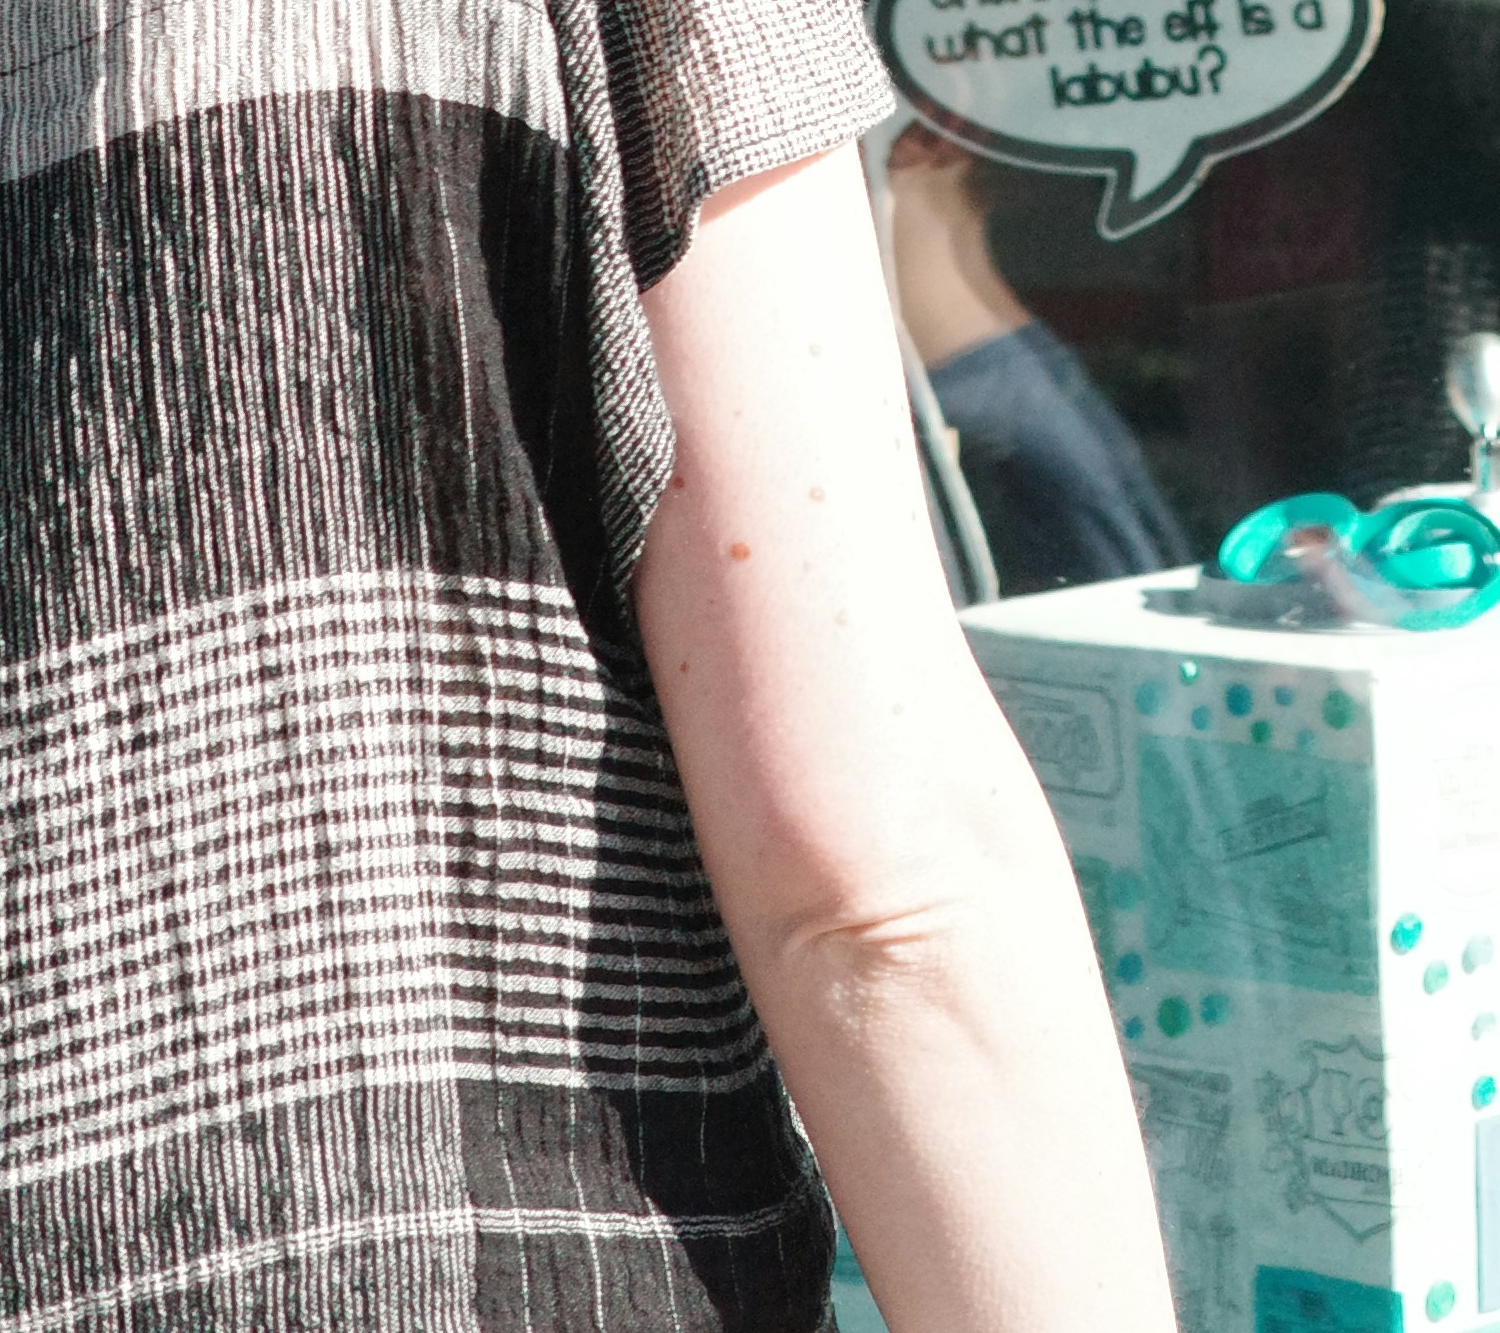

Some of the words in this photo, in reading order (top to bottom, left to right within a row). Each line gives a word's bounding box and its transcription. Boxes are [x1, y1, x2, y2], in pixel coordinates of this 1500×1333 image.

[923, 11, 1051, 64] what
[1066, 7, 1146, 49] the
[1049, 44, 1228, 110] labubu?
